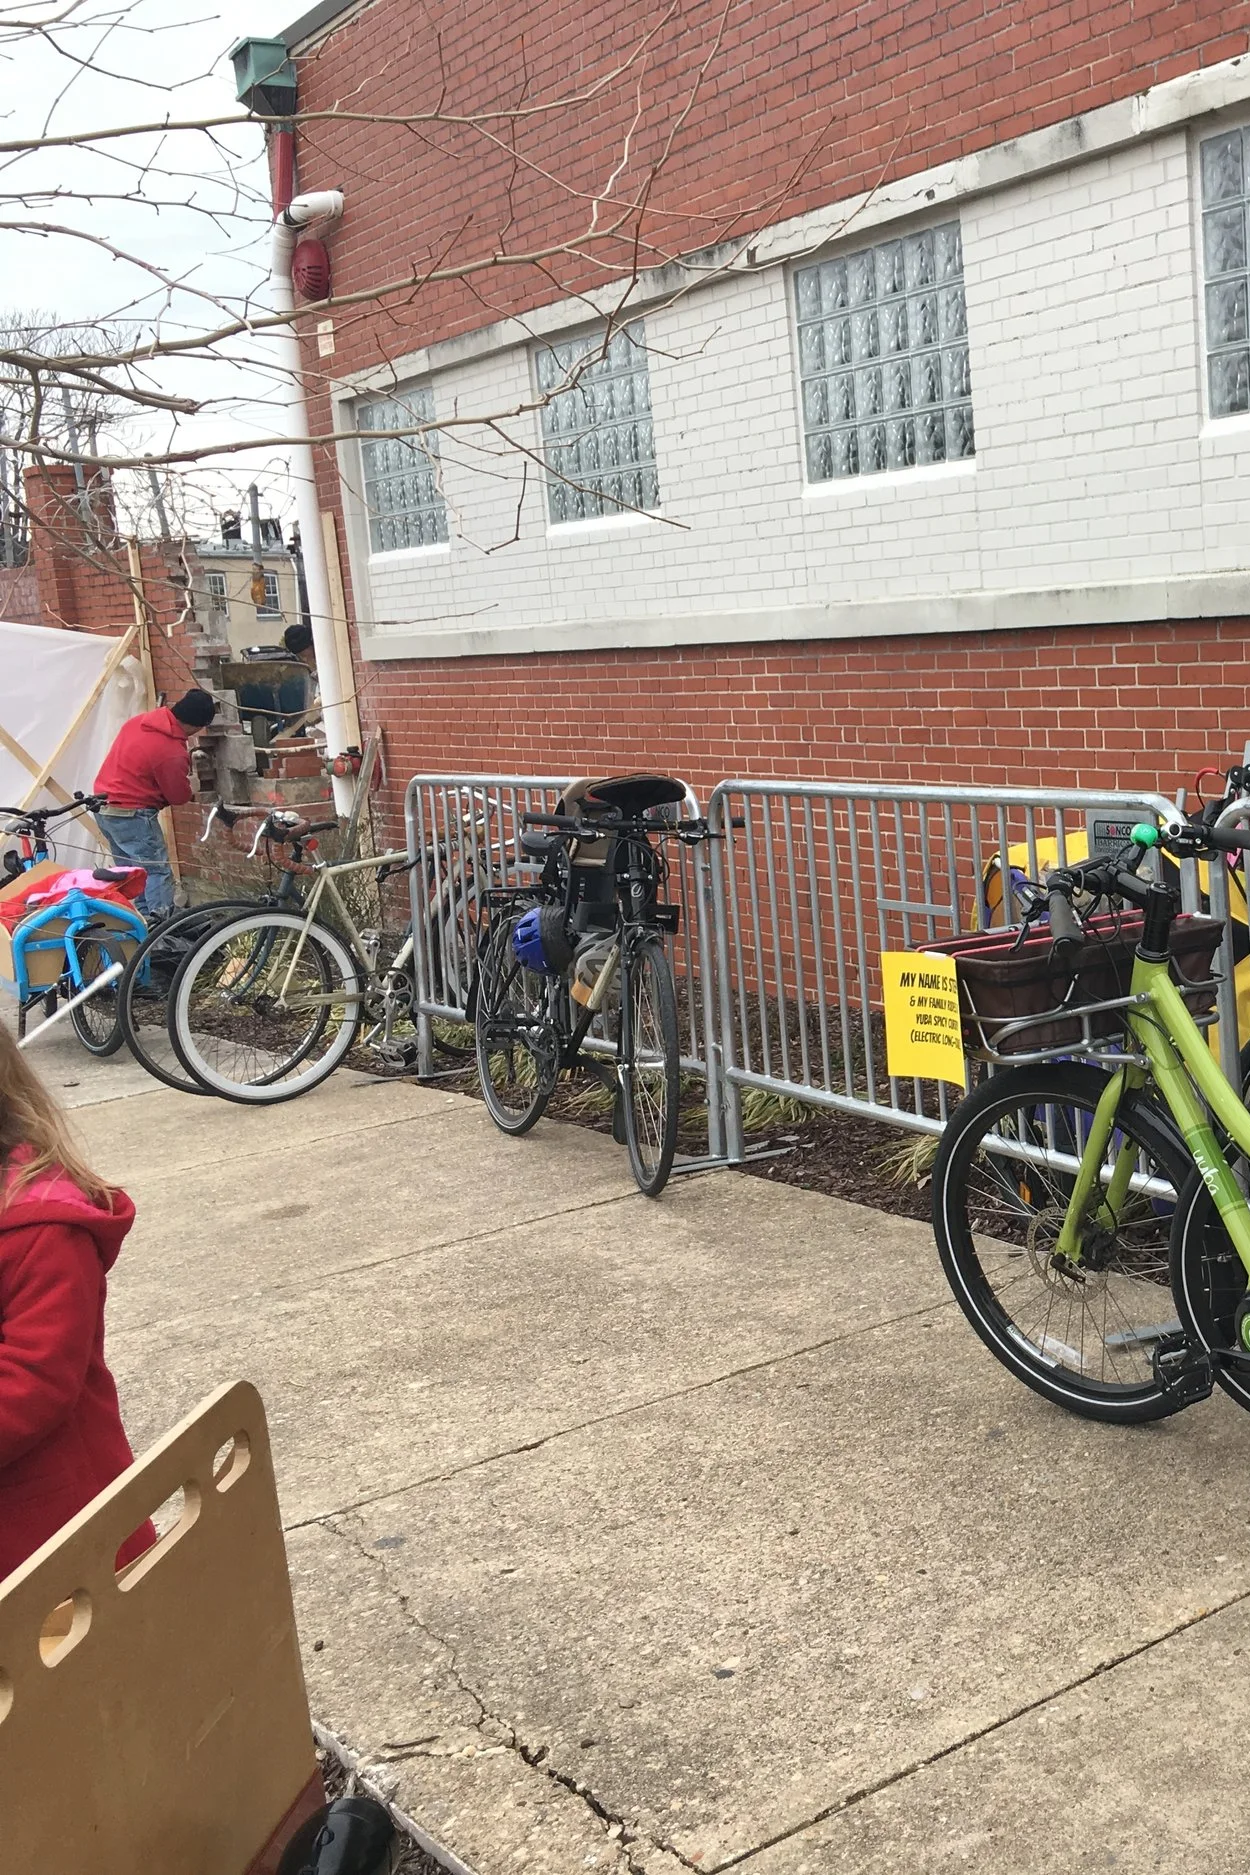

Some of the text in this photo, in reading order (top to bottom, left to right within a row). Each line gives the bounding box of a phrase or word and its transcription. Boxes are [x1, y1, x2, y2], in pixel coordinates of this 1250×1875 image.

[900, 972, 915, 987] MY
[919, 973, 941, 990] NAME
[942, 976, 948, 991] IS
[909, 995, 916, 1007] &
[917, 996, 928, 1007] MY
[929, 997, 946, 1009] FAMILY
[916, 1014, 932, 1025] YUBA
[934, 1015, 948, 1028] SPICY
[911, 1029, 941, 1045] (ELECTRIC
[1192, 1149, 1220, 1196] yuba
